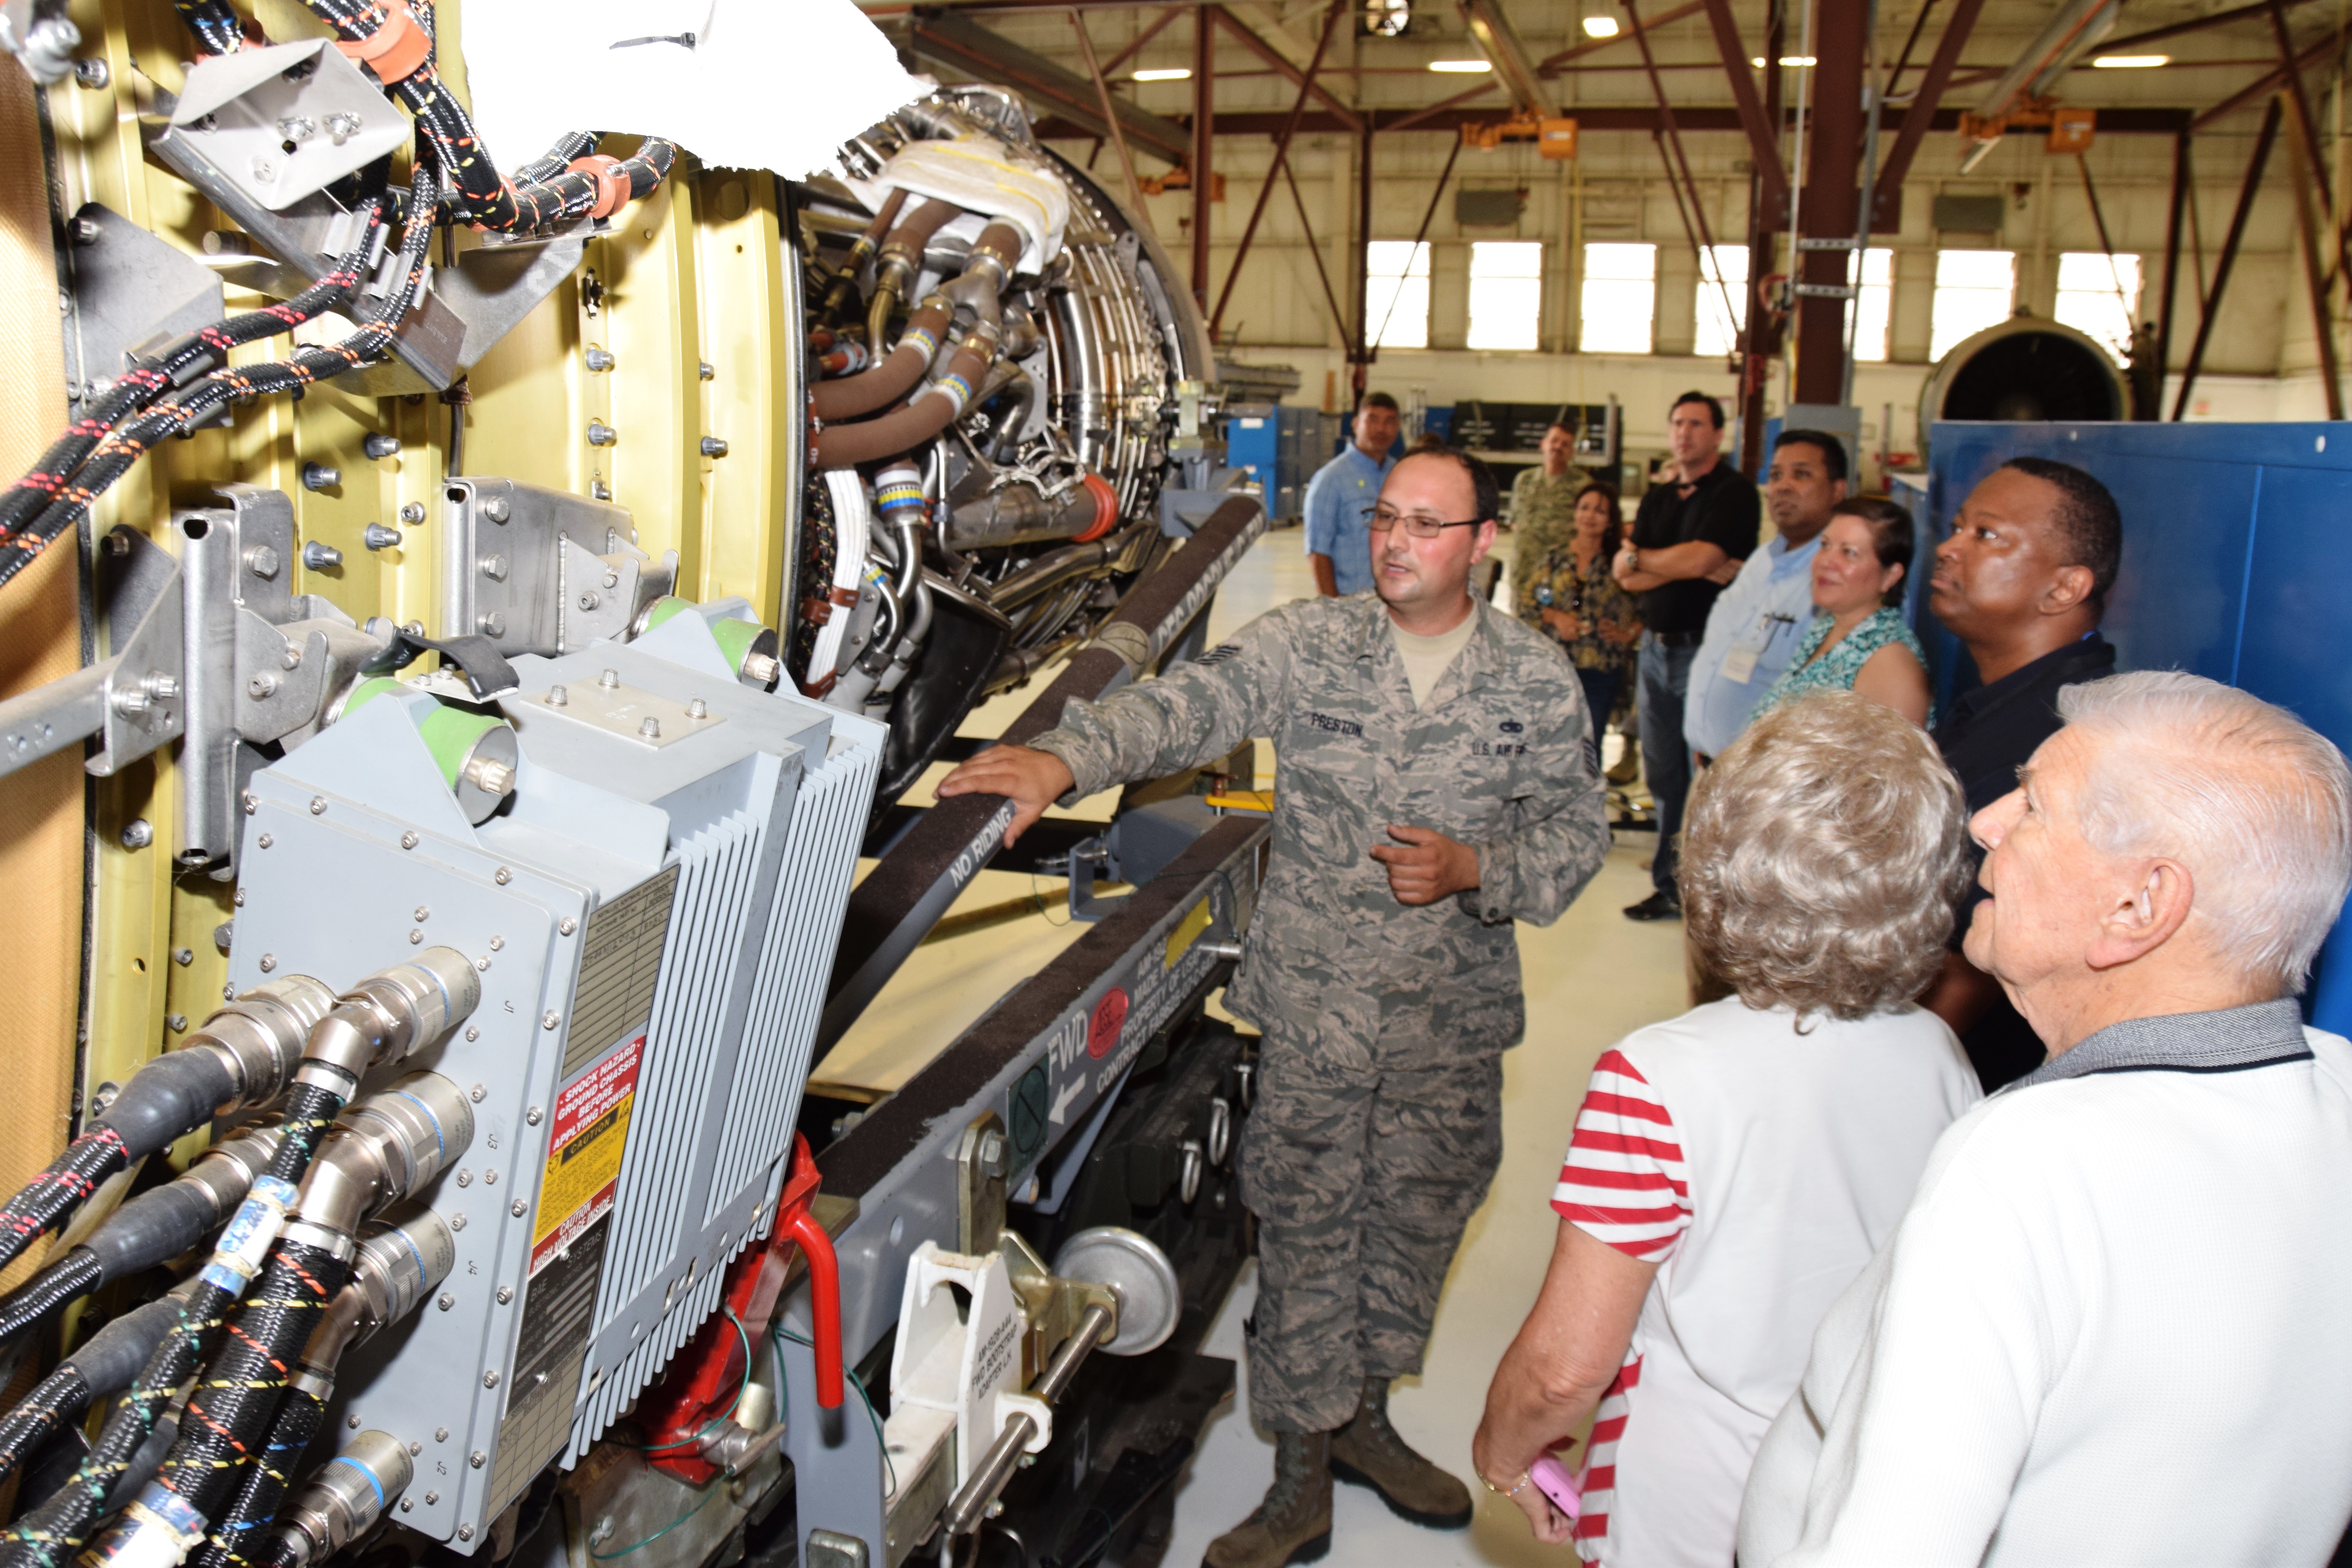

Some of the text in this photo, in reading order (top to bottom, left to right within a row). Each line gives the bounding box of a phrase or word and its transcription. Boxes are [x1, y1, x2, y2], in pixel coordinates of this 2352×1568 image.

[1312, 712, 1363, 737] PRESTON
[949, 806, 1011, 888] NO RIDING
[504, 1000, 514, 1013] J1
[1048, 1009, 1088, 1086] FWD
[557, 1054, 637, 1121] GROUND CHASSIS
[565, 1044, 635, 1102] SHOCK HAZARD
[553, 1082, 632, 1151] APPLYING POWER
[578, 1083, 614, 1119] BEFORE
[488, 1134, 498, 1150] J3
[570, 1117, 611, 1154] CAUTION
[533, 1195, 611, 1272] HIGH VOLTAGE INSIDE
[560, 1200, 592, 1236] CAUTION
[468, 1261, 478, 1275] J4
[531, 1229, 602, 1302] BAE SYSTEMS
[971, 1323, 1017, 1392] FWD BOOTSTRAP
[978, 1359, 1002, 1403] ADAPTER
[437, 1461, 447, 1475] J2
